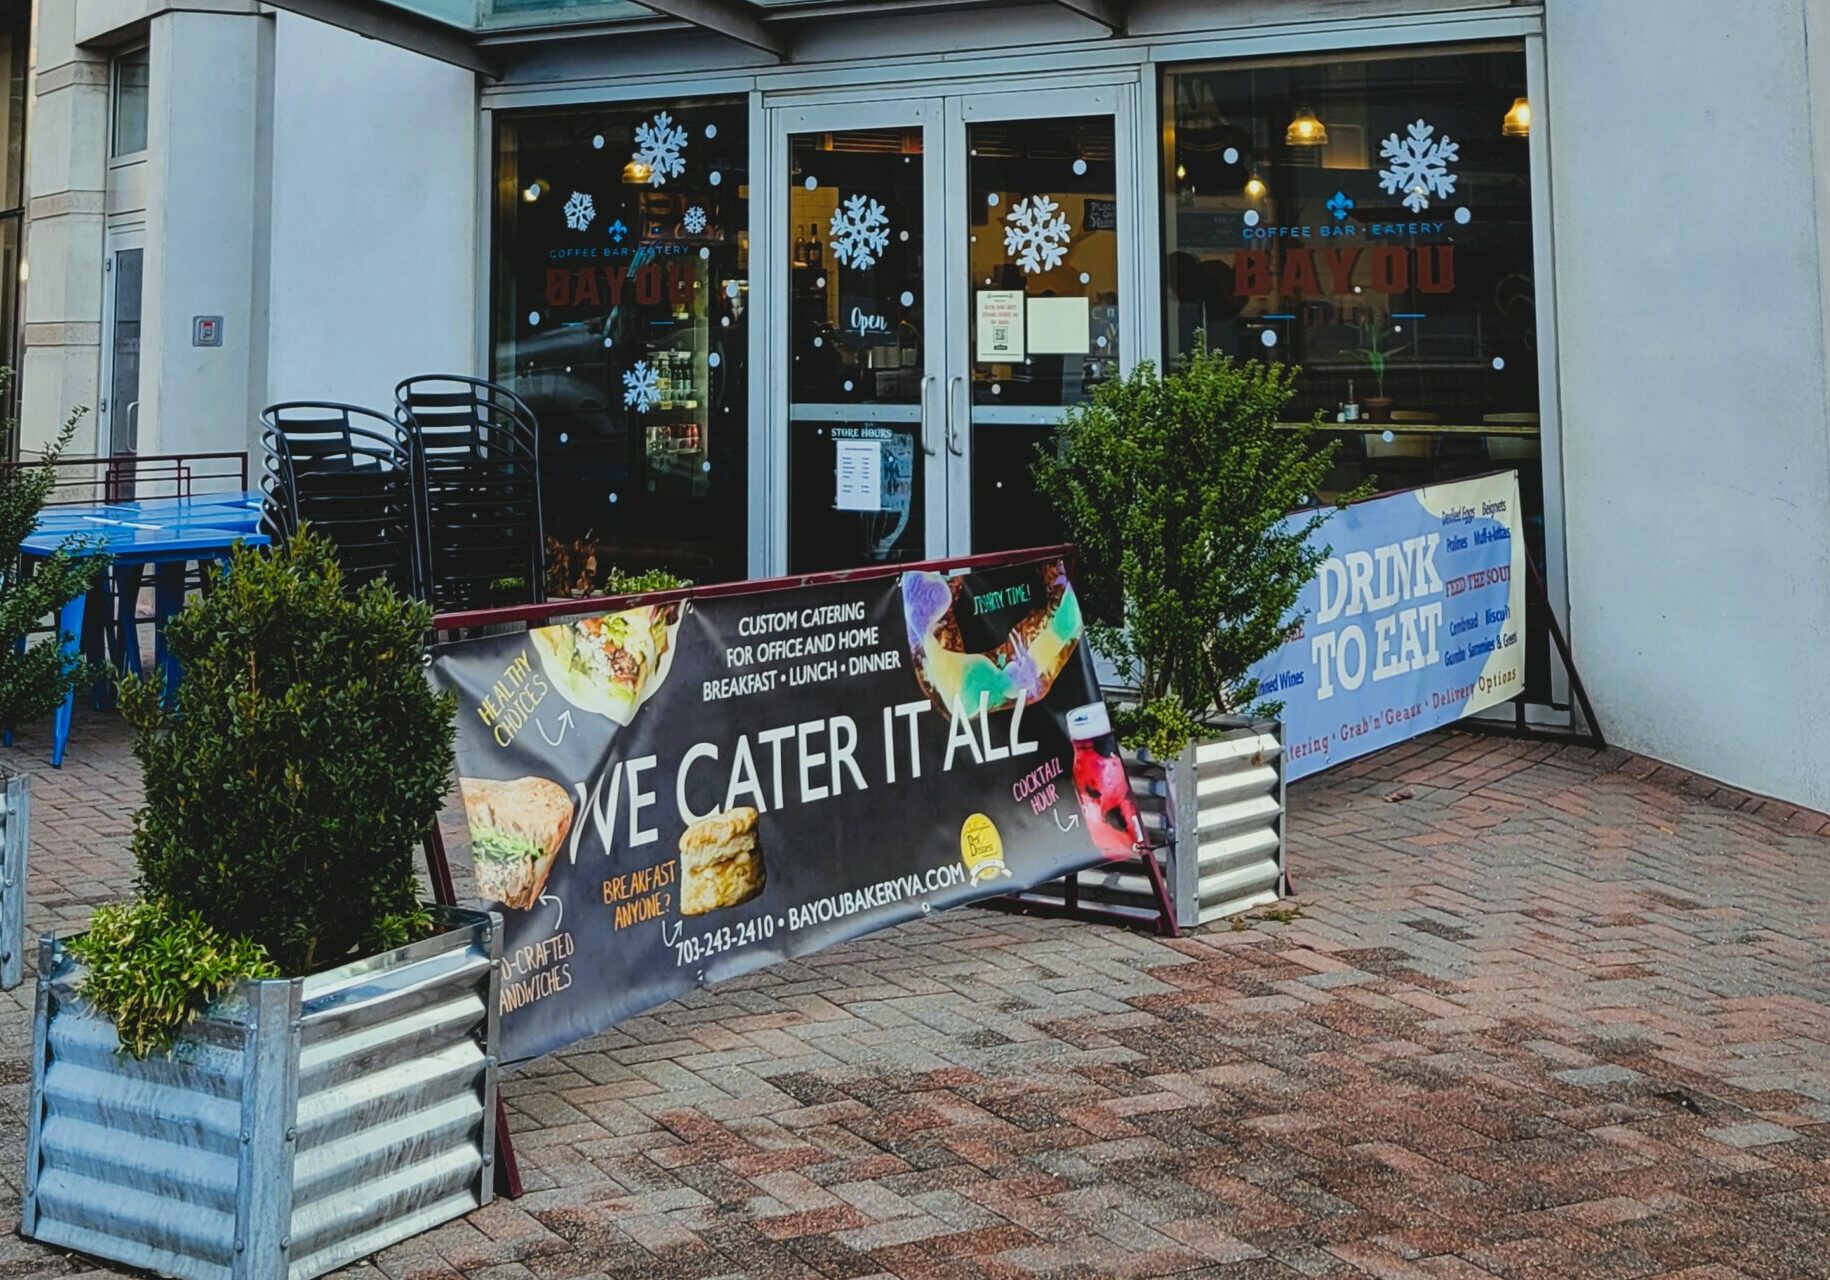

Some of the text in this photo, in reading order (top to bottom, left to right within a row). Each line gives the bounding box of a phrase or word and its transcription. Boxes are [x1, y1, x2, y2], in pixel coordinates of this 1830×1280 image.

[549, 245, 689, 258] COFFEE BAR EATERY
[1243, 226, 1312, 239] COFFEE
[1319, 224, 1356, 237] BAR
[1371, 222, 1444, 236] EATERY
[546, 263, 696, 307] BAYOU
[1233, 245, 1456, 296] BAYOU
[851, 306, 888, 337] Open
[831, 428, 893, 439] STORE HOURS
[1316, 531, 1444, 625] DRINK
[738, 600, 865, 637] CUSTOM CATERING
[726, 626, 879, 669] FOR OFFICE AND HOME
[1311, 600, 1444, 702] TO EAT
[477, 649, 534, 726] HEALTHY
[702, 650, 902, 702] BREAKFAST LUNCH DINNER
[1279, 670, 1304, 690] Wines
[493, 677, 549, 748] CHOICES
[1286, 735, 1329, 762] tering
[1432, 683, 1475, 709] Delivery
[1478, 669, 1517, 694] Options
[569, 687, 1040, 866] WE CATER IT ALL
[1012, 757, 1064, 803] COCKTAIL
[1030, 783, 1061, 816] HOUR
[603, 859, 677, 905] BREAKFAST
[613, 893, 672, 932] ANYONE?
[675, 862, 965, 967] 703-243-2410 BAYOUBAKERYVA.COM
[500, 932, 574, 980] D-CRAFTED
[500, 963, 572, 1017] ANDWICHES
